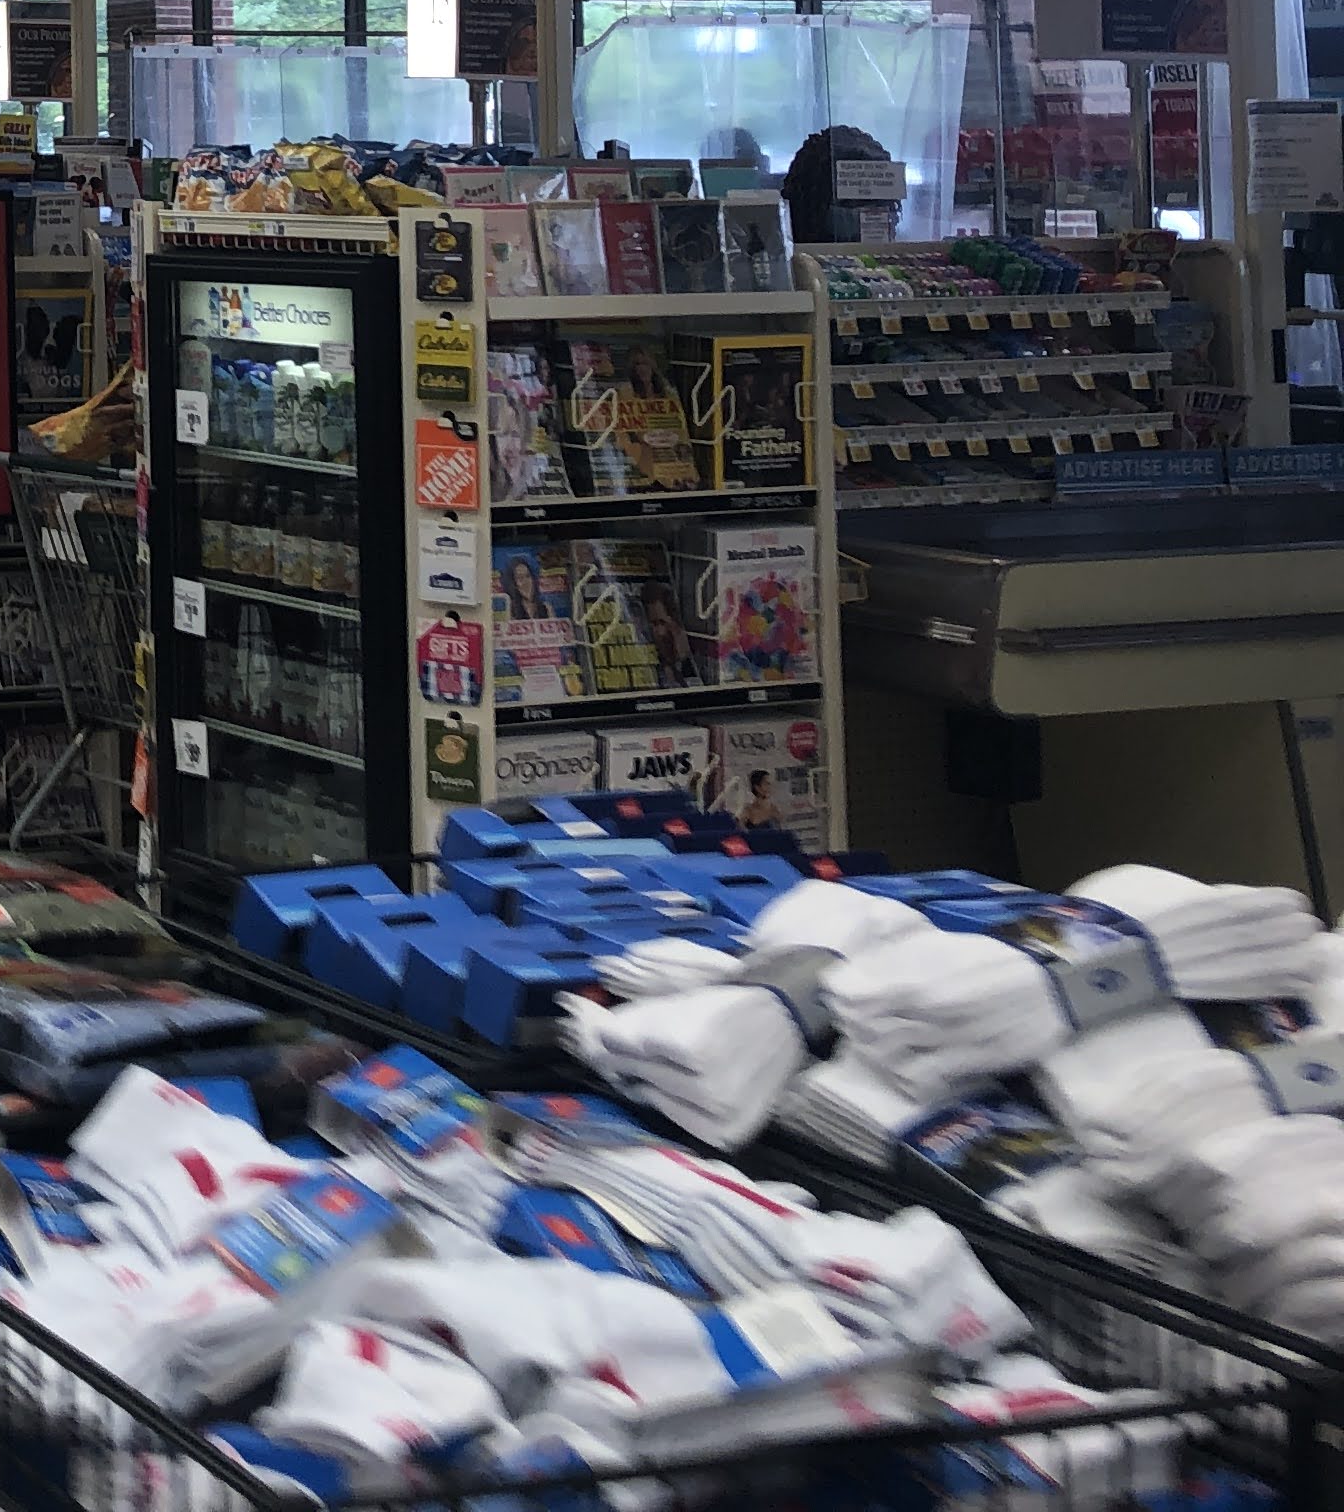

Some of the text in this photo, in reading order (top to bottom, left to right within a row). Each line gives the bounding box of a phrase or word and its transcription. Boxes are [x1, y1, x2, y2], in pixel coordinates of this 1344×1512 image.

[17, 28, 40, 41] OUR
[3, 122, 32, 136] GREAT
[252, 300, 332, 327] Better Choices
[725, 425, 787, 442] Founding
[739, 439, 803, 458] Fathers
[417, 446, 476, 504] HOME
[1062, 456, 1215, 480] ADVERTISE HERE
[1234, 451, 1333, 476] ADVERTISE
[627, 751, 693, 781] JAWS
